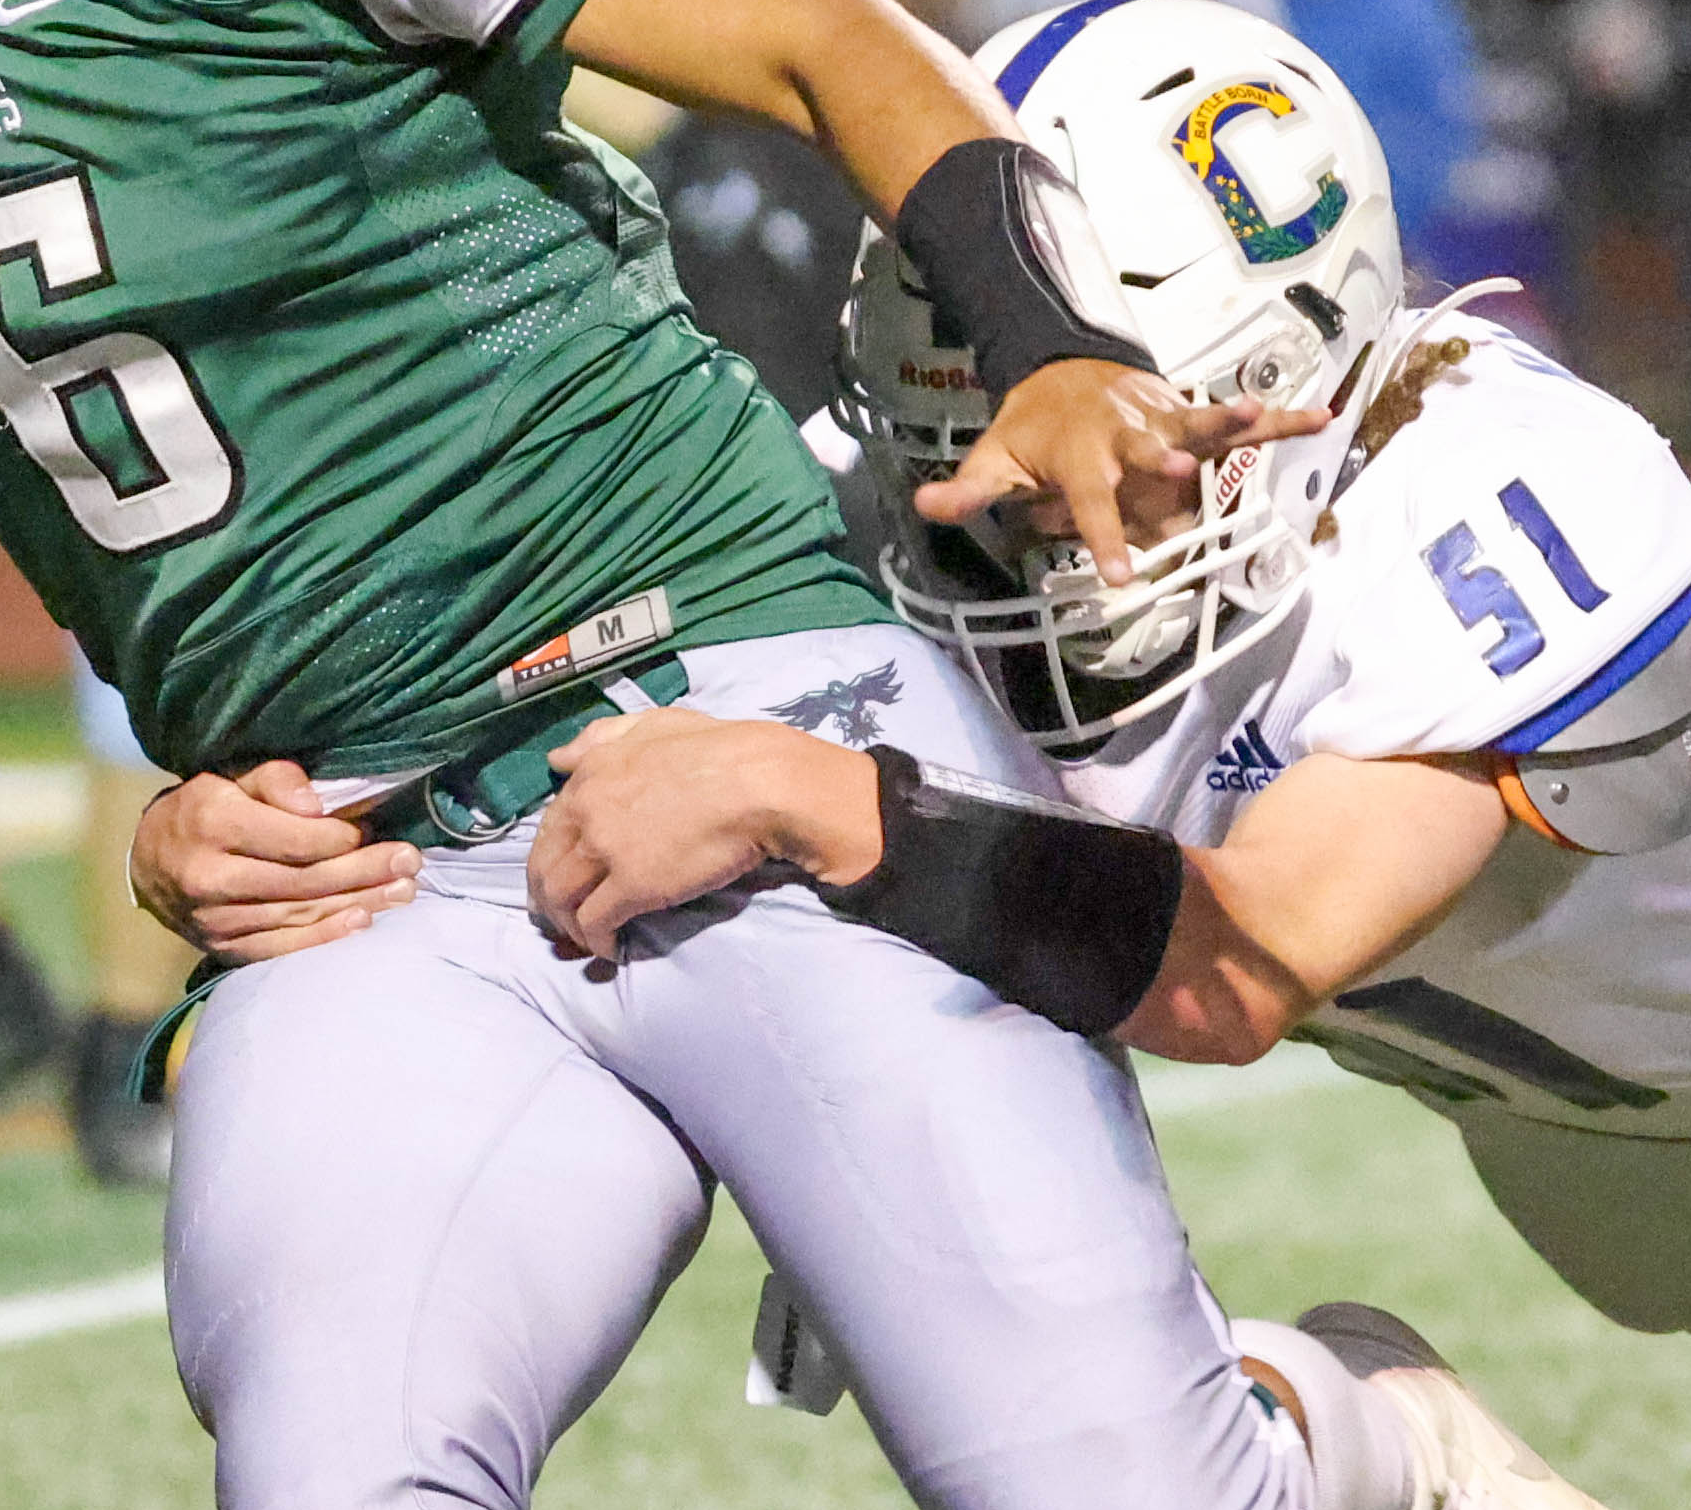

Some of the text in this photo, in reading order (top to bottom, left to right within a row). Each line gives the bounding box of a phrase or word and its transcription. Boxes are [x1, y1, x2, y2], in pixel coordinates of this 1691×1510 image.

[1194, 85, 1270, 140] BATTLE BORN
[1167, 77, 1352, 269] C
[1215, 443, 1261, 507] idde
[1419, 476, 1612, 682] 51
[596, 614, 625, 645] M
[519, 655, 568, 680] TEAM
